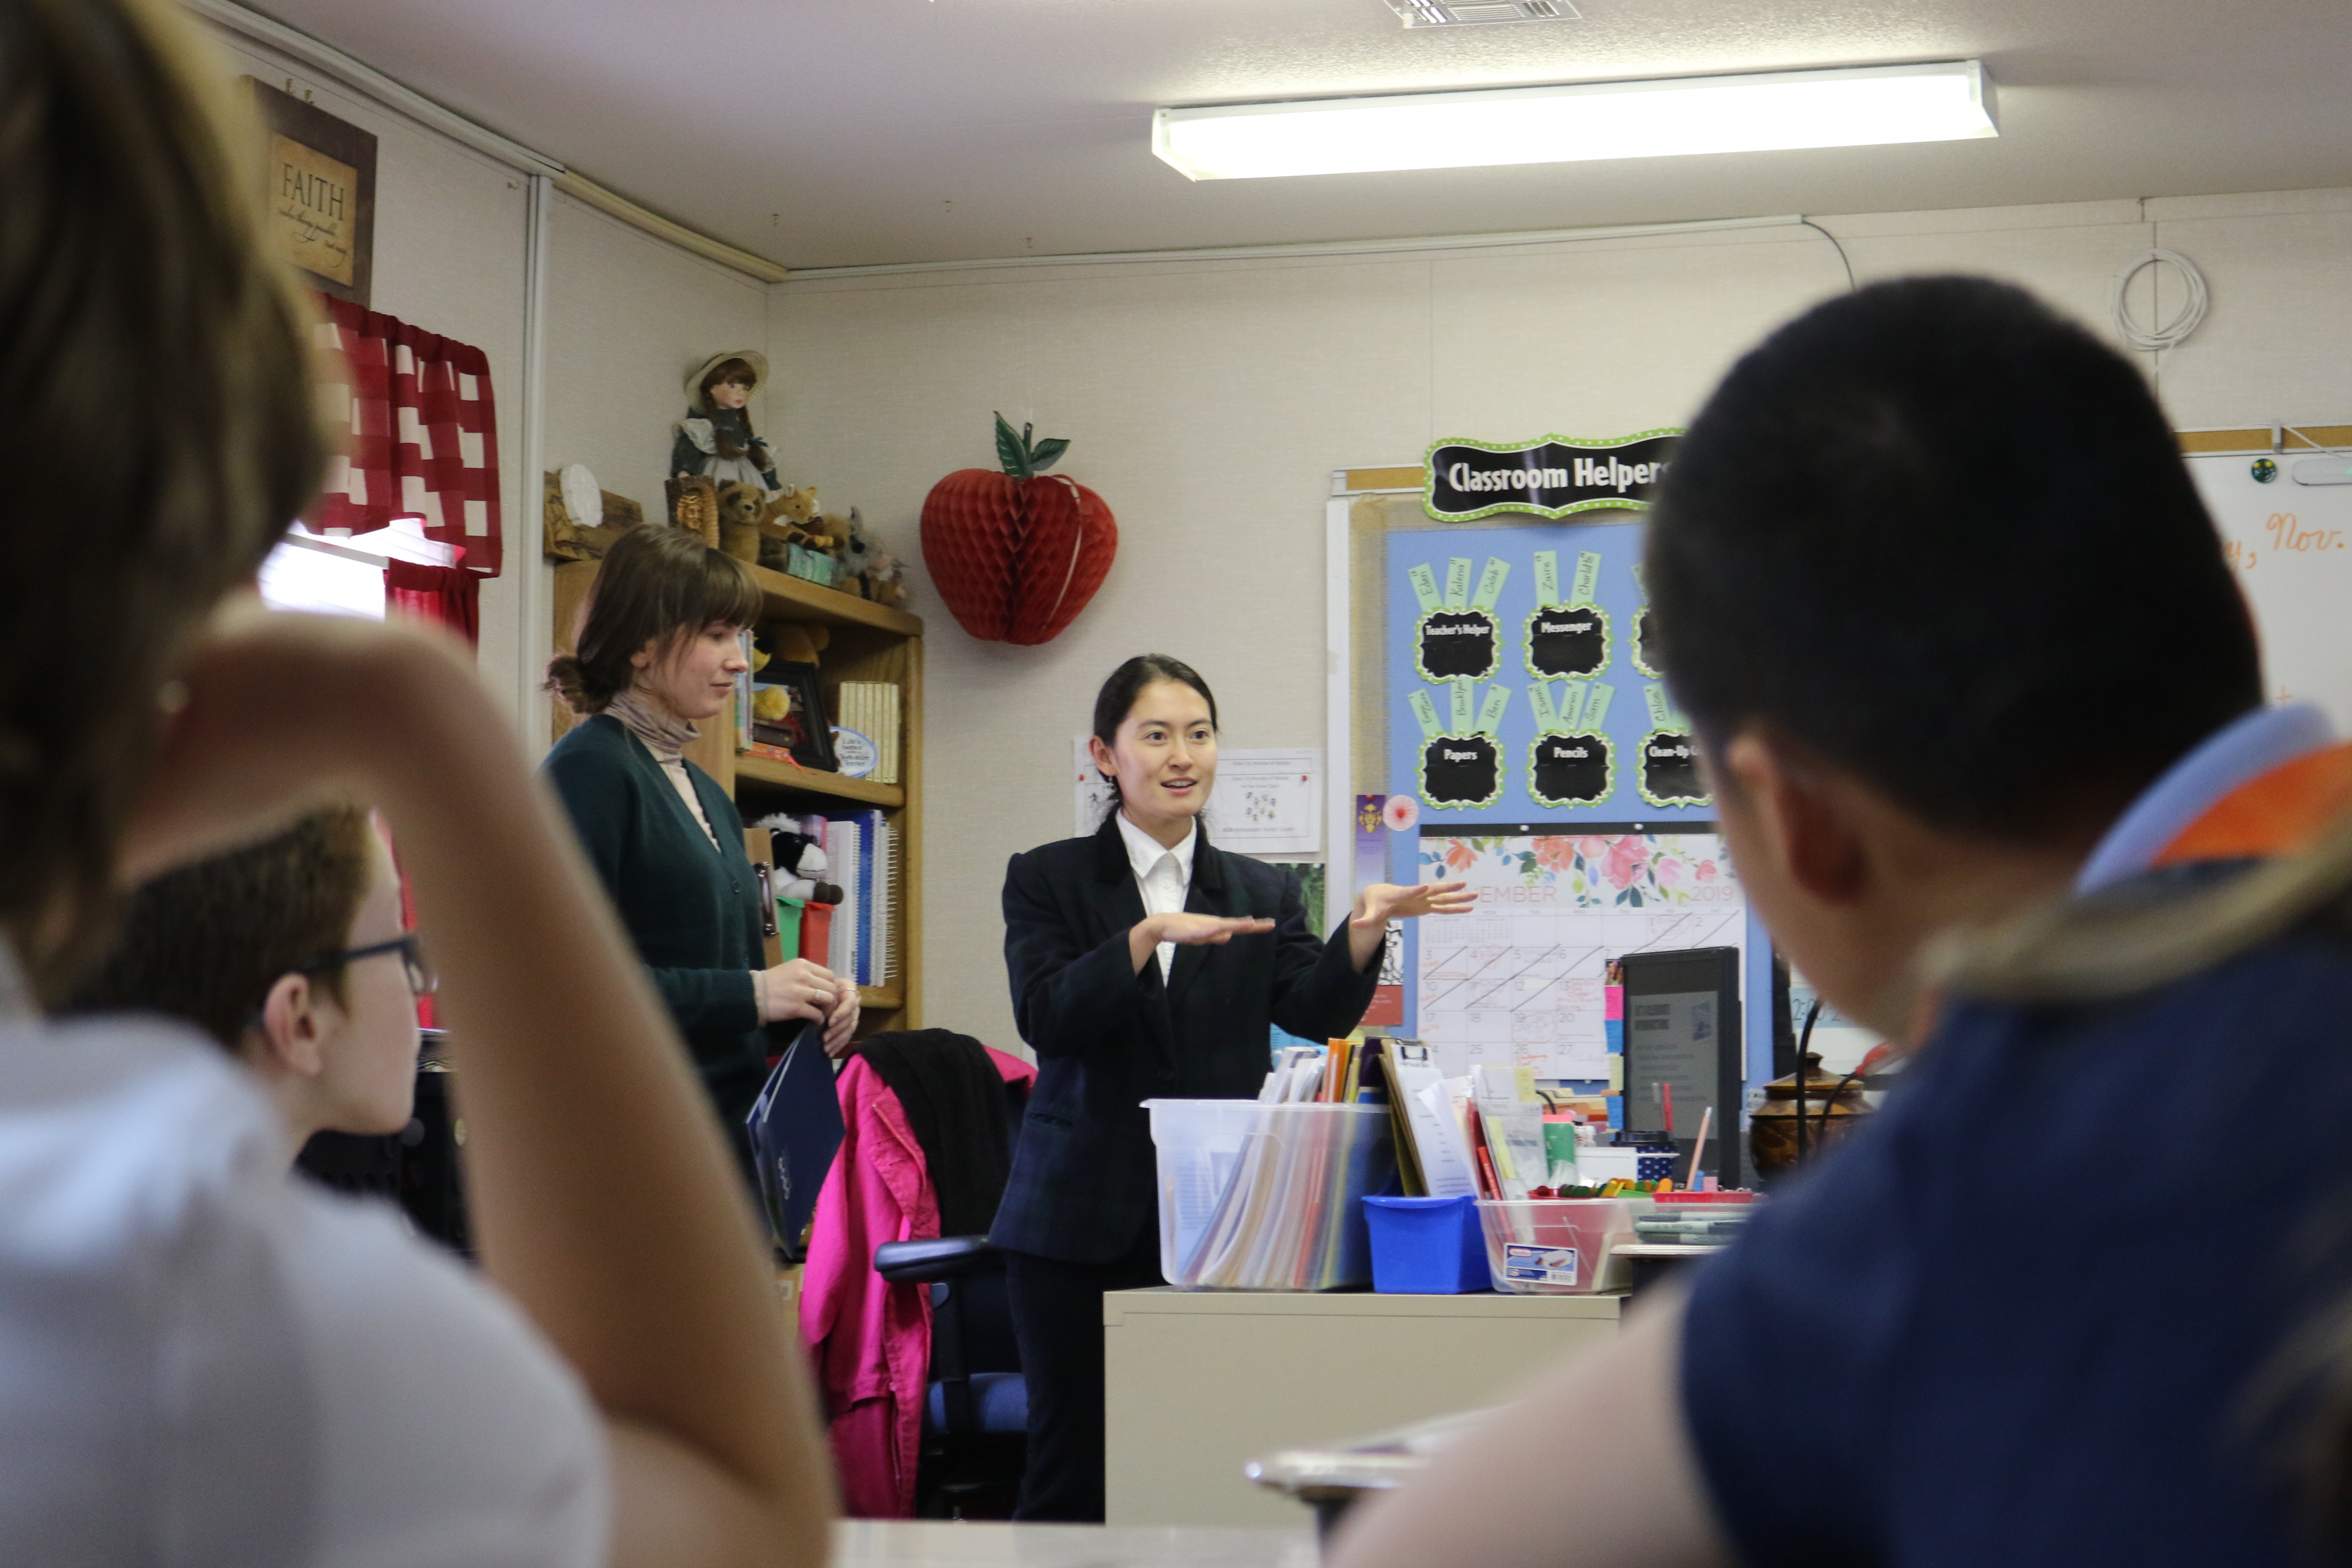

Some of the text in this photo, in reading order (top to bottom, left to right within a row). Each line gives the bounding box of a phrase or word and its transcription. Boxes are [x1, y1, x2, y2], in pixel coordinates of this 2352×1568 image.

[282, 163, 344, 221] FAITH
[1449, 462, 1568, 492] Classroom
[2266, 512, 2345, 551] Nov.
[1418, 571, 1434, 596] Eden
[1484, 570, 1499, 594] Caleb
[1578, 556, 1595, 595] Charlotte
[1425, 624, 1491, 637] Teacher's Helper
[1541, 622, 1593, 634] Messenger
[1486, 700, 1501, 718] Ben
[1535, 686, 1550, 718] Isaac
[1585, 698, 1601, 722] Sam
[1444, 749, 1478, 763] Papers
[1553, 747, 1589, 758] Pencils
[1648, 745, 1690, 759] Clean-Up
[1477, 885, 1734, 903] EMBER 2019
[1695, 917, 1703, 927] 2
[1425, 949, 1432, 960] 3
[1470, 949, 1477, 958] 4
[1514, 949, 1521, 959] 5
[1559, 949, 1566, 959] 6
[1425, 982, 1437, 991] 10
[1514, 981, 1525, 991] 12
[1425, 1013, 1436, 1023] 17
[1469, 1013, 1481, 1023] 18
[1559, 1013, 1574, 1023] 20
[1469, 1044, 1483, 1054] 25
[1514, 1044, 1528, 1054] 26
[1559, 1044, 1573, 1054] 27
